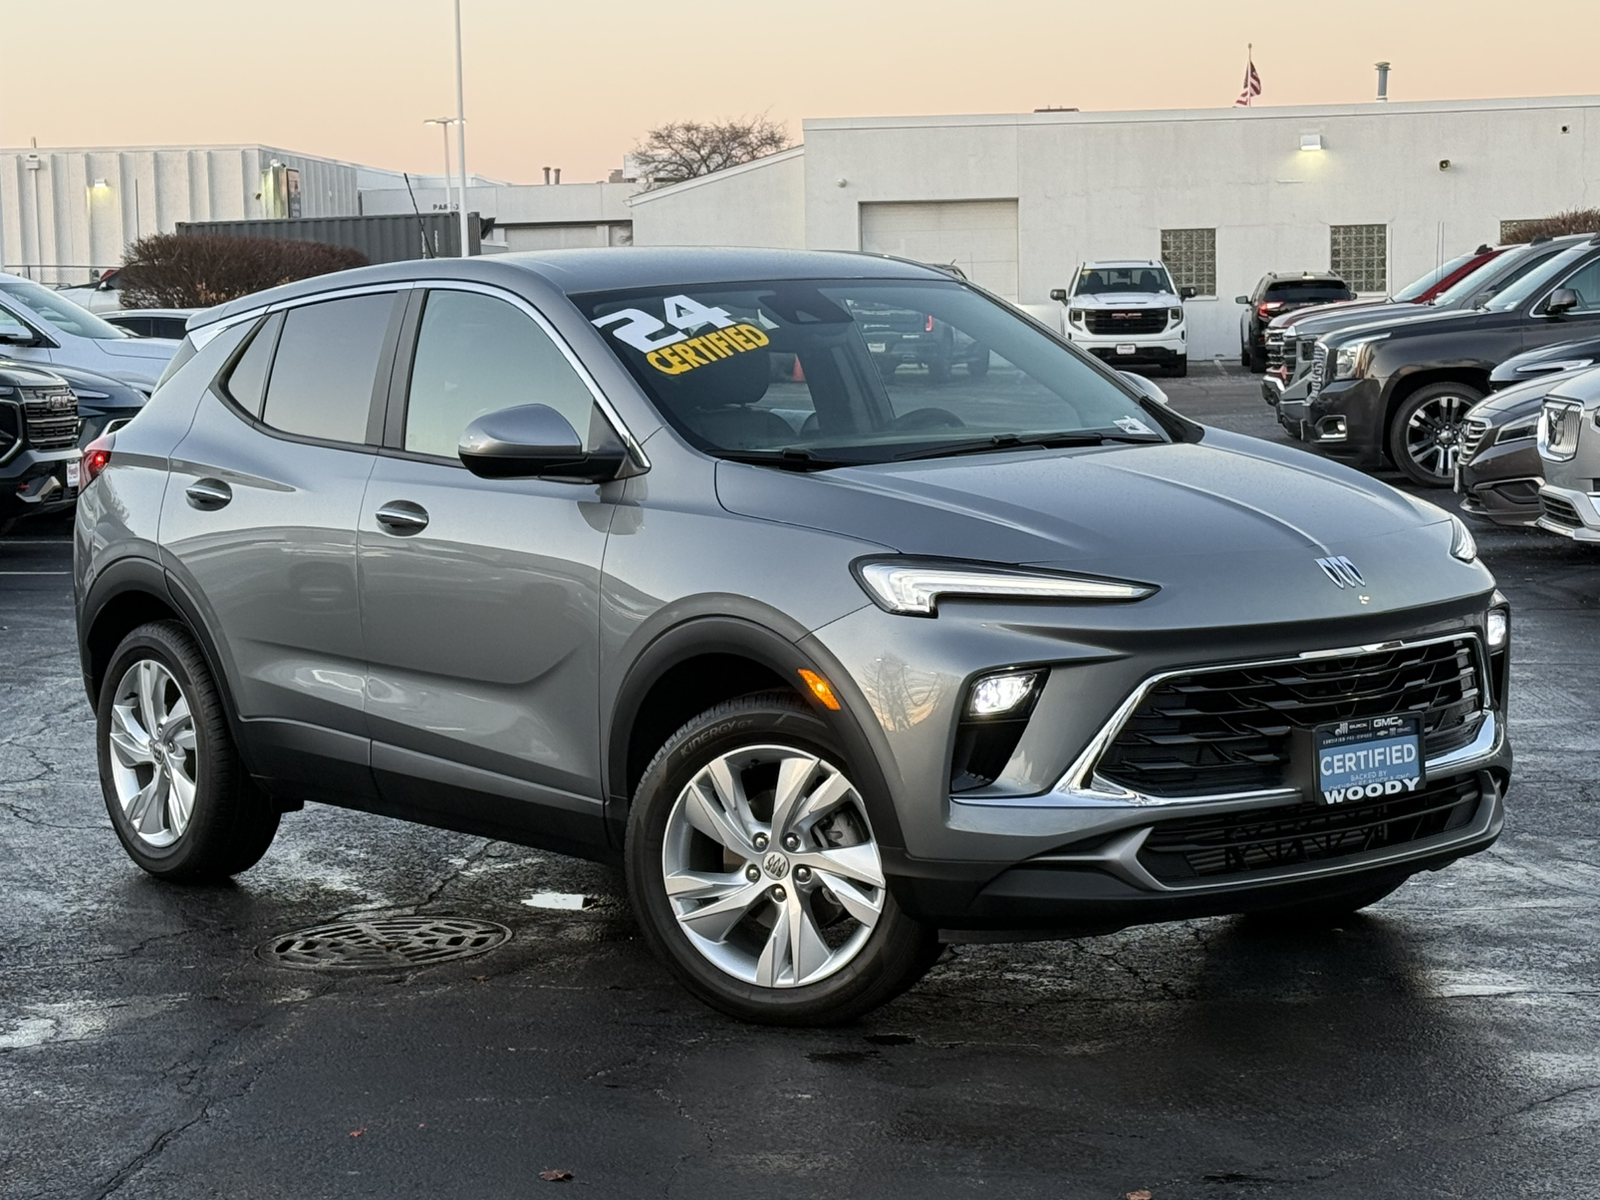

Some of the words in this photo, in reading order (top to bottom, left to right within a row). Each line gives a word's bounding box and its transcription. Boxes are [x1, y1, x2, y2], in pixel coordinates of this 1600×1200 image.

[590, 294, 736, 354] 24
[646, 323, 770, 375] CERTIFIED
[680, 720, 736, 757] KINERGY
[1348, 722, 1368, 730] BUICK
[1373, 716, 1399, 728] GMC
[1320, 743, 1417, 776] CERTIFIED
[1350, 771, 1377, 782] BACKED
[1378, 769, 1387, 777] BY
[1323, 777, 1421, 805] WOODY
